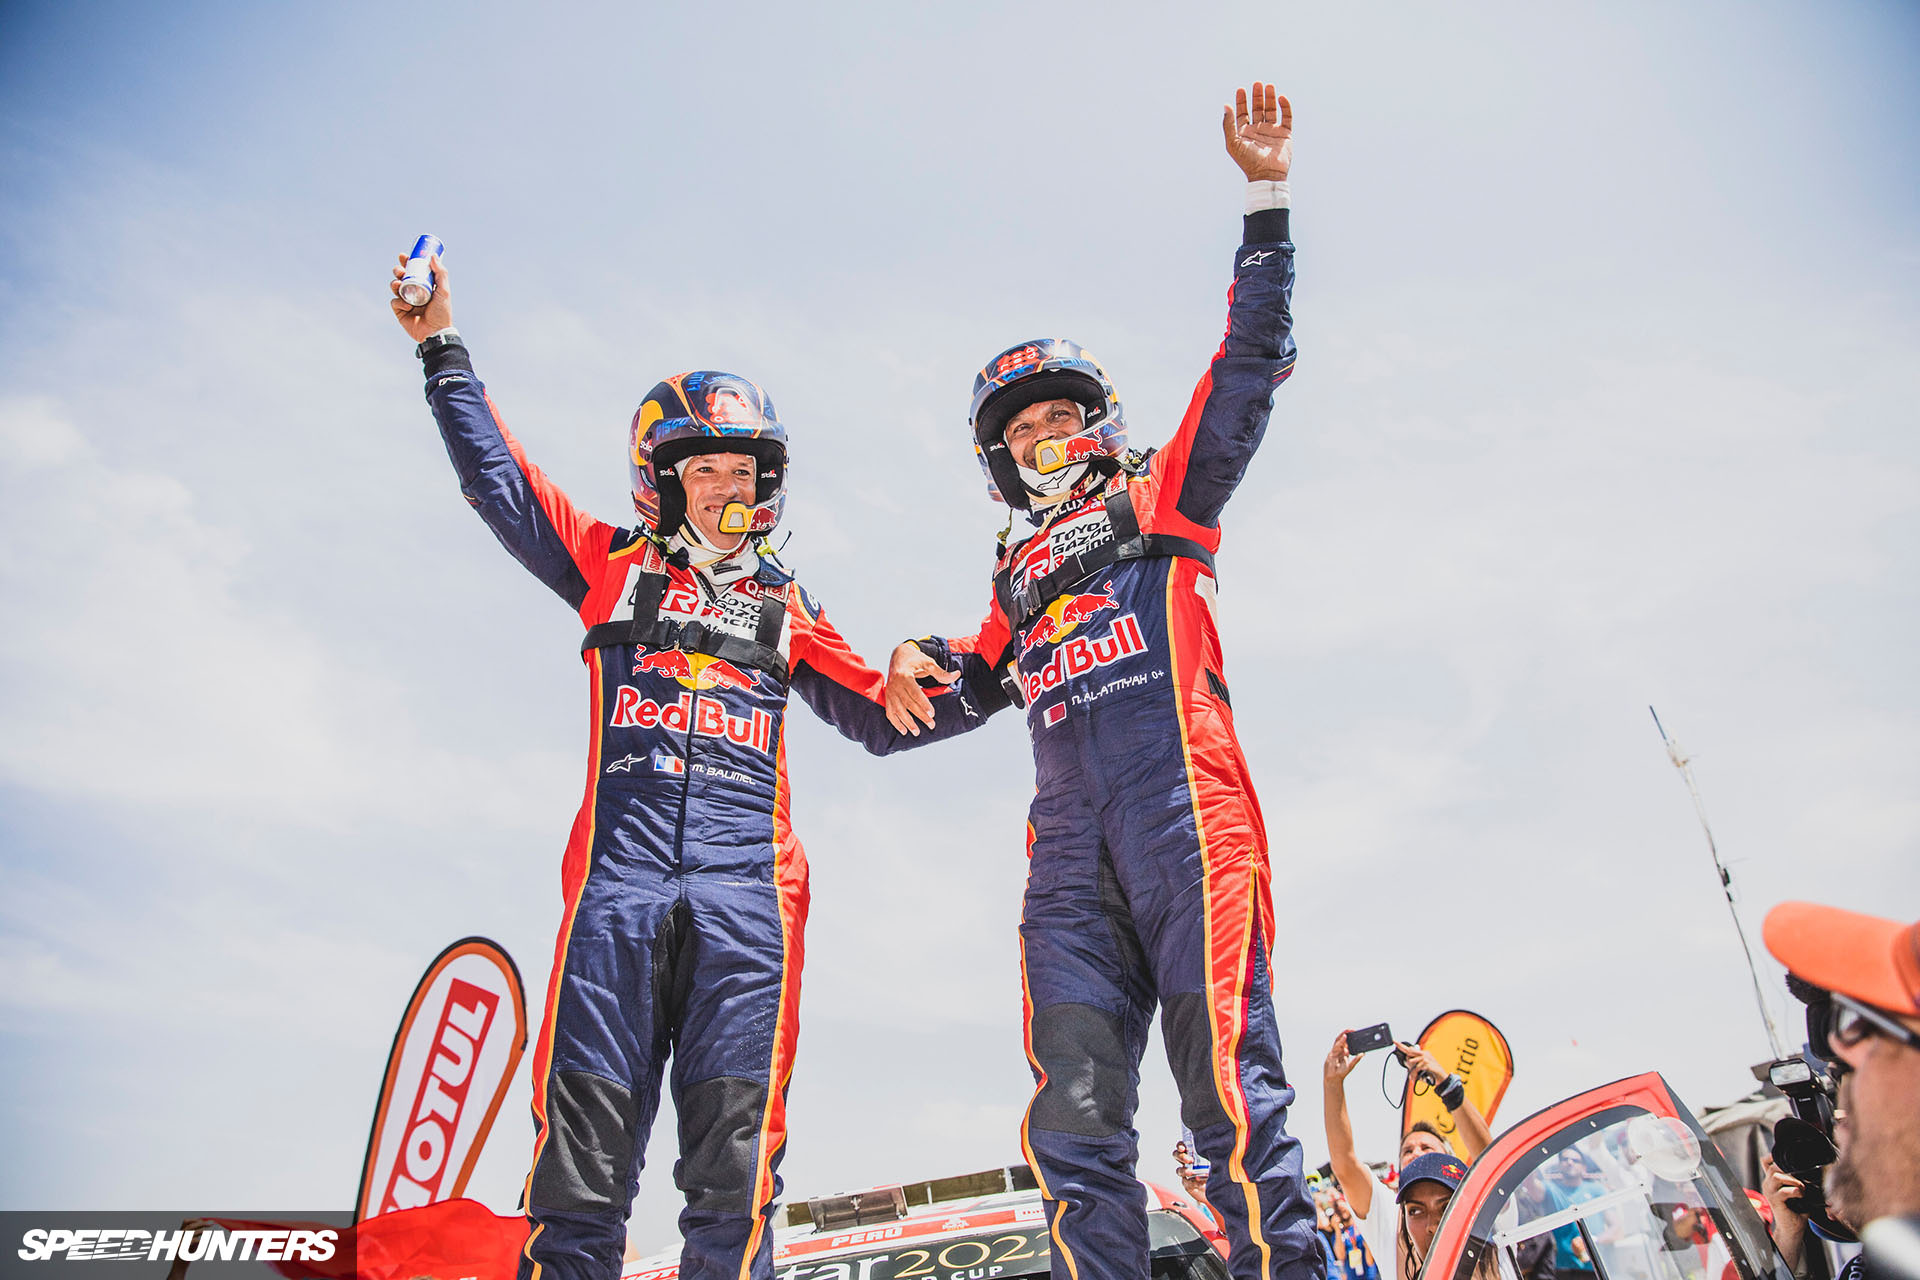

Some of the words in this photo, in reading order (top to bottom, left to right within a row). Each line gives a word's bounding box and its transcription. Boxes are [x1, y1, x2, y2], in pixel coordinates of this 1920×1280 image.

[1022, 649, 1065, 710] Red
[1061, 612, 1149, 680] Bull
[1083, 673, 1148, 702] AL-ATTIYAH
[609, 685, 694, 734] Red
[693, 694, 772, 756] Bull
[950, 1265, 1004, 1280] CUP
